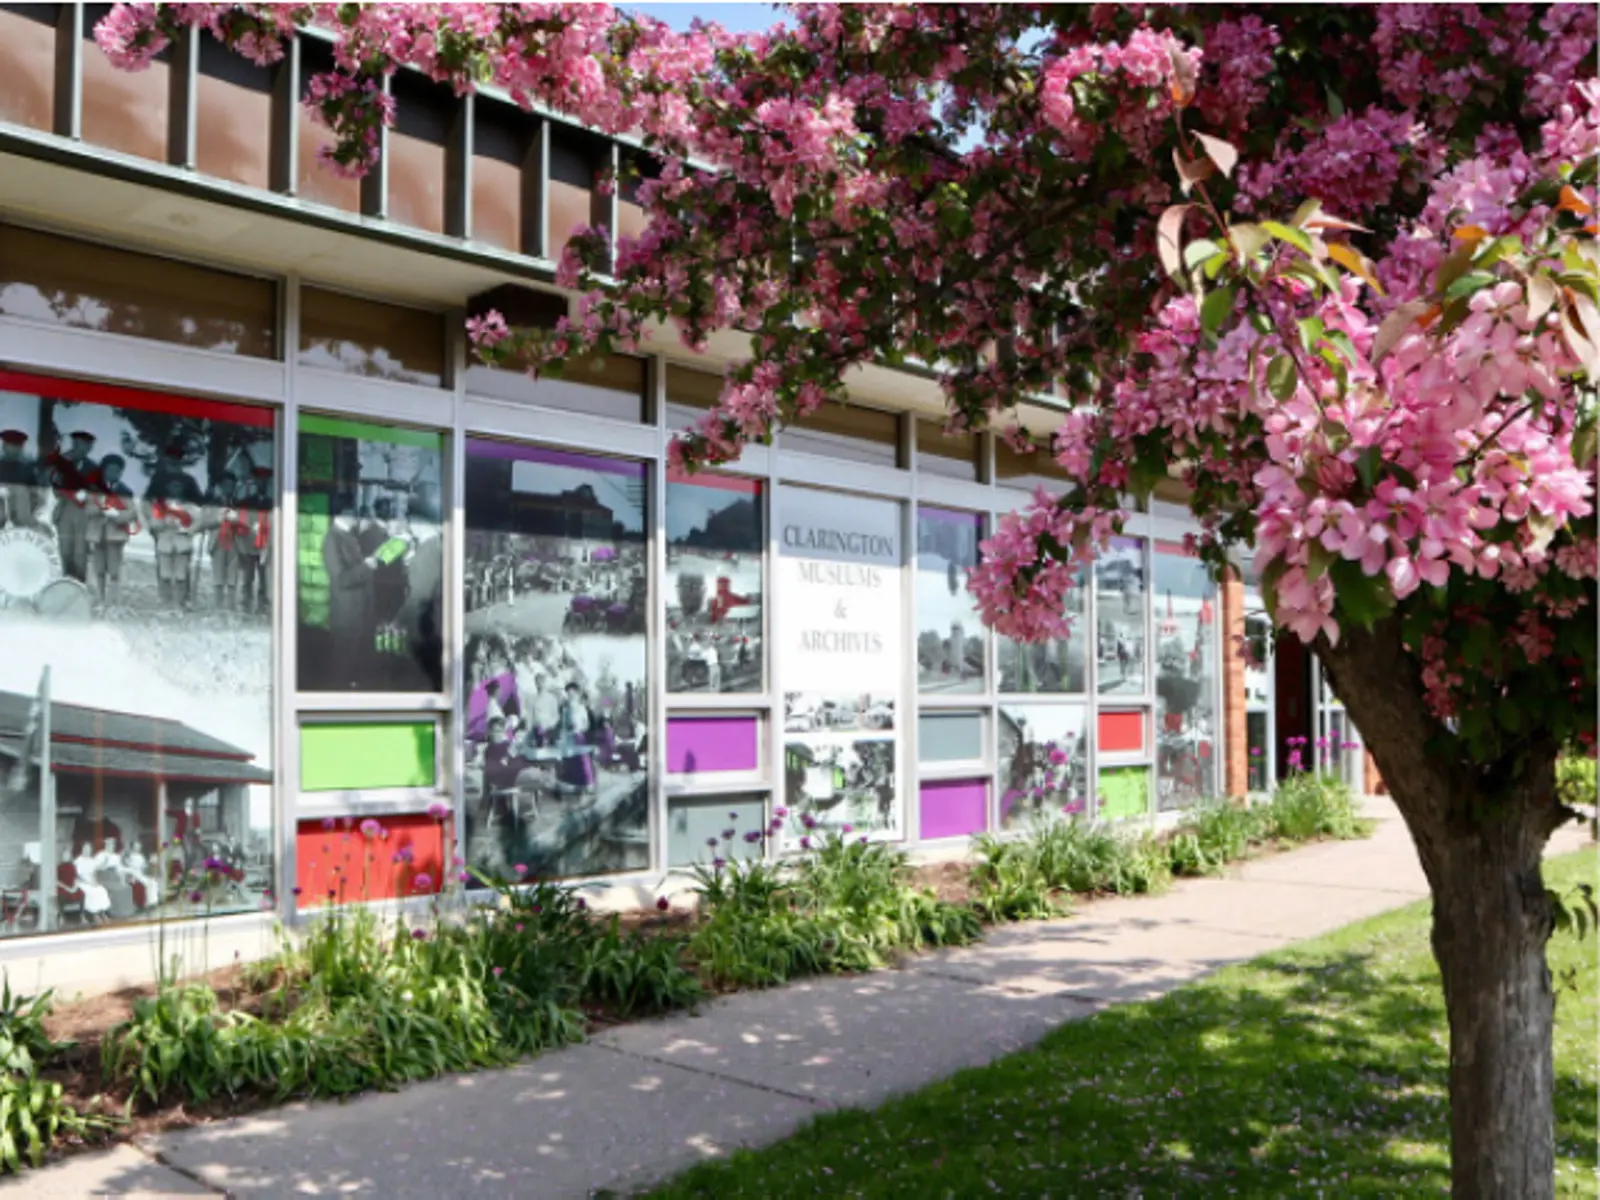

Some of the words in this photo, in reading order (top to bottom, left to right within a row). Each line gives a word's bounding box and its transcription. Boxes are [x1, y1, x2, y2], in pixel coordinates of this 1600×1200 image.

[784, 524, 893, 557] CLARINGTON
[797, 561, 883, 588] MUSEUMS
[833, 598, 848, 620] &
[798, 628, 884, 654] ARCHIVES
